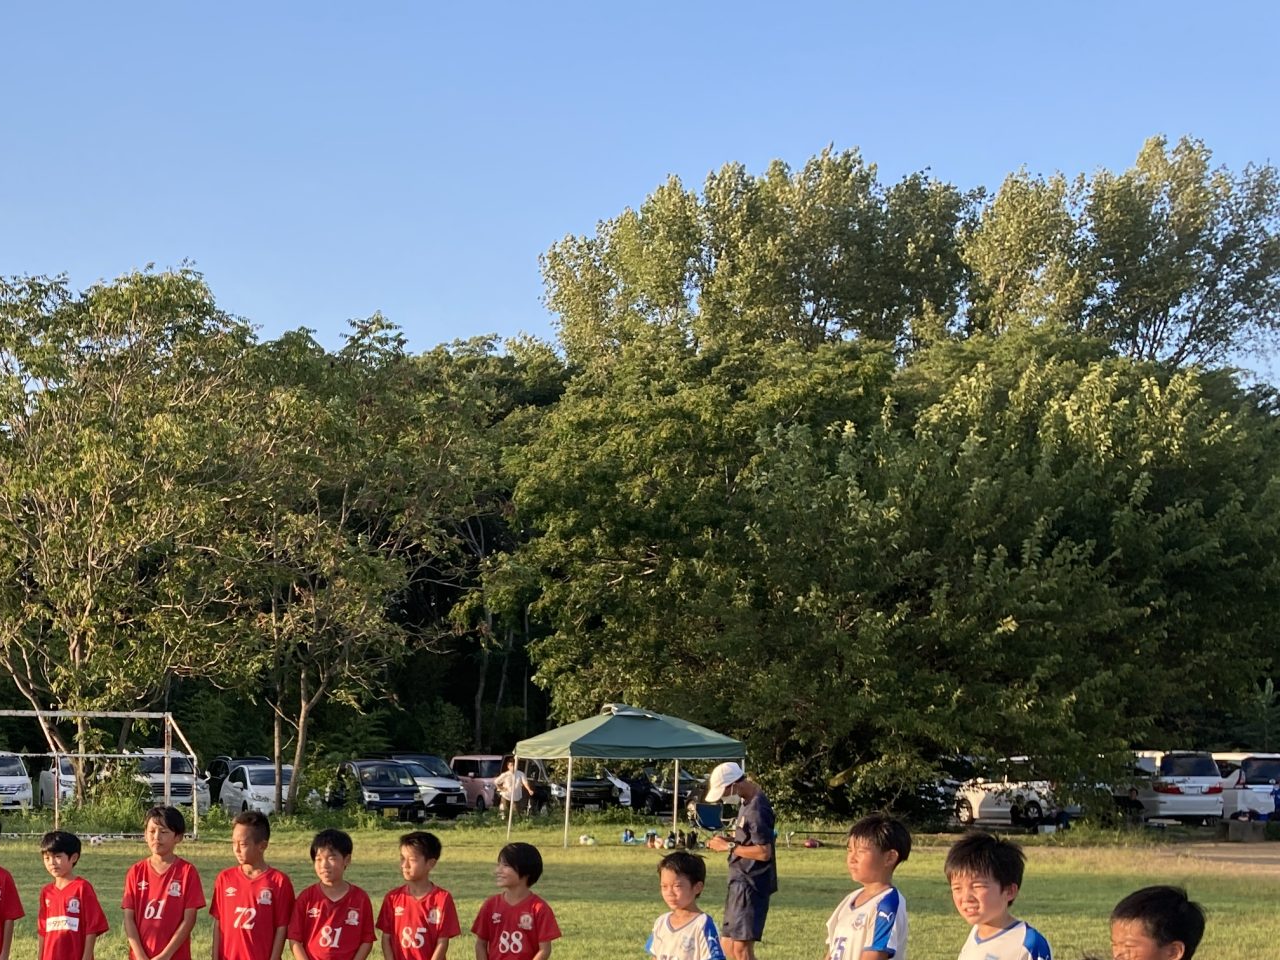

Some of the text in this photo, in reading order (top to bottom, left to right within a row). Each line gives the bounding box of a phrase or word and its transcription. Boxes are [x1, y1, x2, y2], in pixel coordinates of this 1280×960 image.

[143, 899, 166, 920] 61
[233, 907, 257, 930] 72
[319, 926, 342, 948] 81
[401, 926, 427, 949] 85
[499, 931, 523, 954] 88
